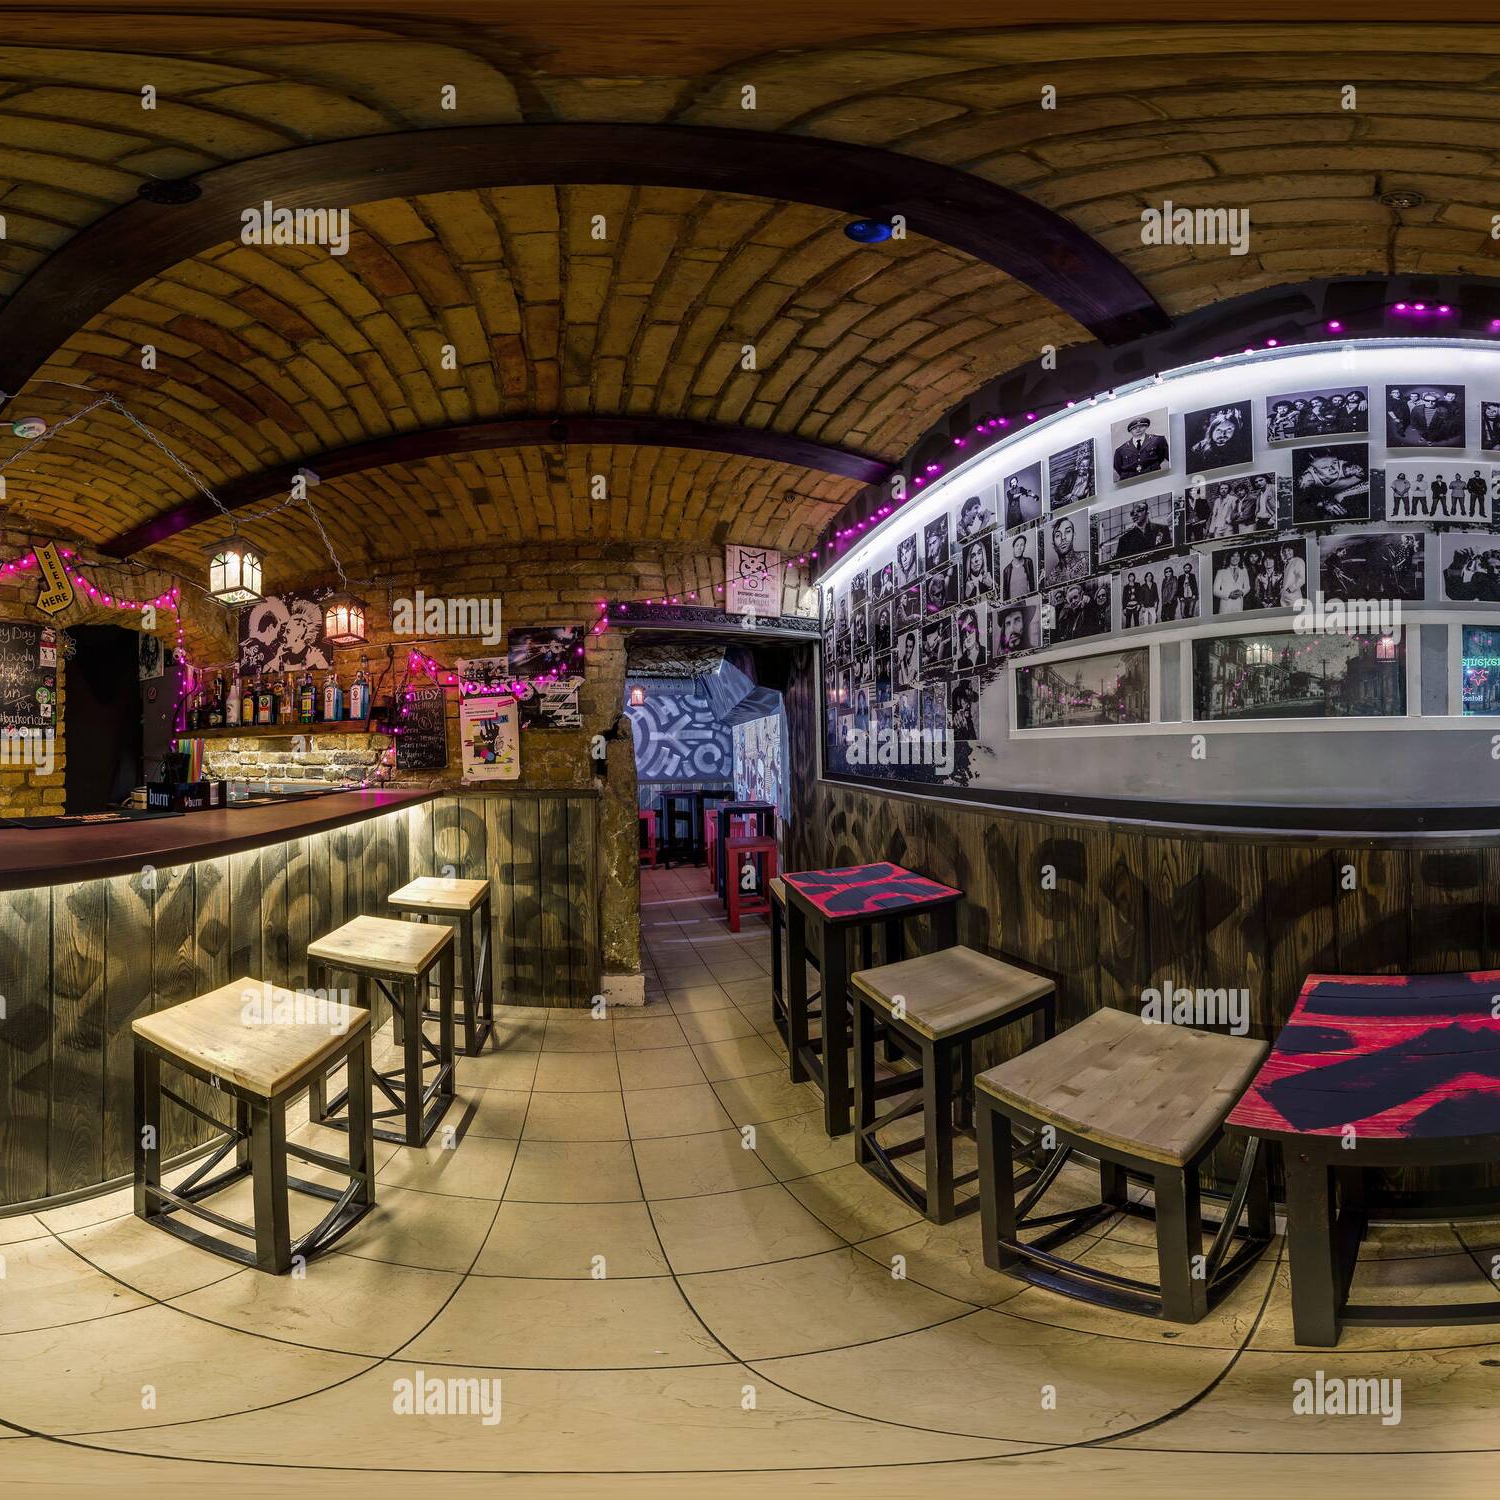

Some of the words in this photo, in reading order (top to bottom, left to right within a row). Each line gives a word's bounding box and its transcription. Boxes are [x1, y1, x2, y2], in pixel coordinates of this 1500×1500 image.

[43, 551, 64, 590] BEER
[41, 593, 68, 608] HERE
[13, 631, 36, 645] Day
[149, 788, 168, 807] burn
[188, 796, 202, 808] burn
